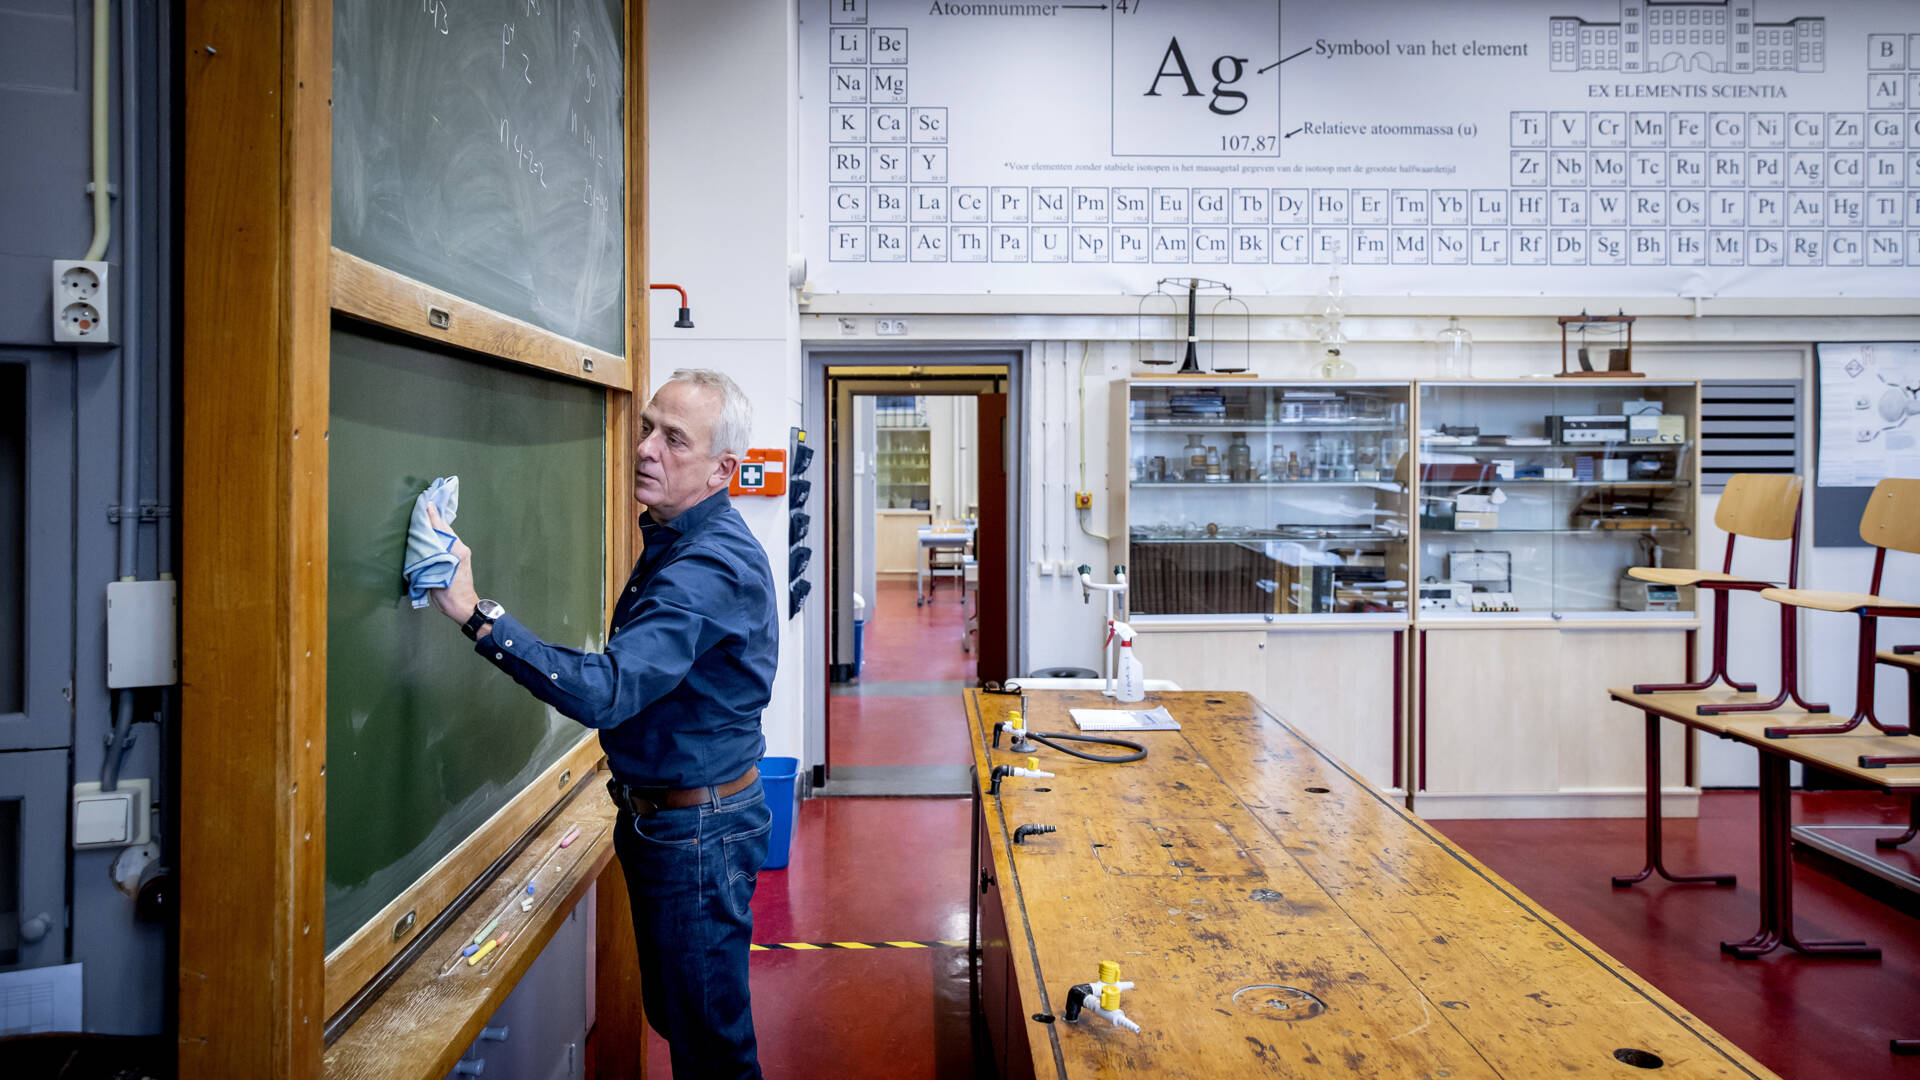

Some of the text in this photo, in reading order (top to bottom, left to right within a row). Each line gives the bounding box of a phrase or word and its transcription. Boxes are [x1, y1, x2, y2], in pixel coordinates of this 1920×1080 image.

[842, 0, 855, 12] H
[928, 0, 1059, 16] Atoomnummer
[1115, 0, 1140, 14] 47
[840, 34, 901, 52] Li Be
[1315, 38, 1528, 59] Symbool van het element
[1881, 41, 1894, 57] B
[1143, 36, 1249, 116] Ag
[837, 75, 903, 95] Na Mg
[1588, 84, 1788, 98] EX ELEMENTIS SCIENTIA
[1876, 80, 1897, 97] Al
[842, 114, 940, 131] K Ca Sc
[1304, 121, 1478, 137] Relatieve atoommassa (u)
[1519, 119, 1899, 136] Ti V Cr Mn Fe Co Ni Cu Zn Ga
[1222, 135, 1276, 152] 107,87
[837, 154, 936, 170] Rb Sr Y
[1519, 158, 1895, 180] Zr Nb Mo Tc Ru Rh Pd Ag Cd In
[837, 193, 1895, 219] Cs Ba La Ce Pr Nd Pm Sm Eu Gd Tb Dy Ho Er Tm Yb Lu Hf Ta W Re Os Ir Pt Au Hg Tl
[840, 233, 858, 249] Fr
[878, 233, 900, 249] Ra
[917, 234, 941, 249] Ac
[958, 233, 981, 249] Th
[1001, 234, 1020, 249] Pa
[1044, 234, 1057, 250] U
[1079, 234, 1103, 254] Np
[1121, 234, 1141, 250] Pu
[1155, 235, 1186, 250] Am
[1195, 235, 1225, 251] Cm
[1240, 235, 1262, 251] Bk
[1280, 235, 1304, 251] Cf
[1357, 236, 1384, 251] Fm
[1397, 236, 1424, 252] Md
[1438, 236, 1463, 252] No
[1481, 236, 1500, 252] Lr
[1520, 236, 1542, 252] Rf
[1557, 236, 1581, 252] Db
[1598, 237, 1620, 257] Sg
[1637, 237, 1660, 253] Bh
[1678, 237, 1699, 253] Hs
[1716, 237, 1738, 253] Mt
[1755, 237, 1778, 253] Ds
[1794, 237, 1818, 258] Rg
[1833, 237, 1857, 254] Cn
[1873, 237, 1898, 253] Nh
